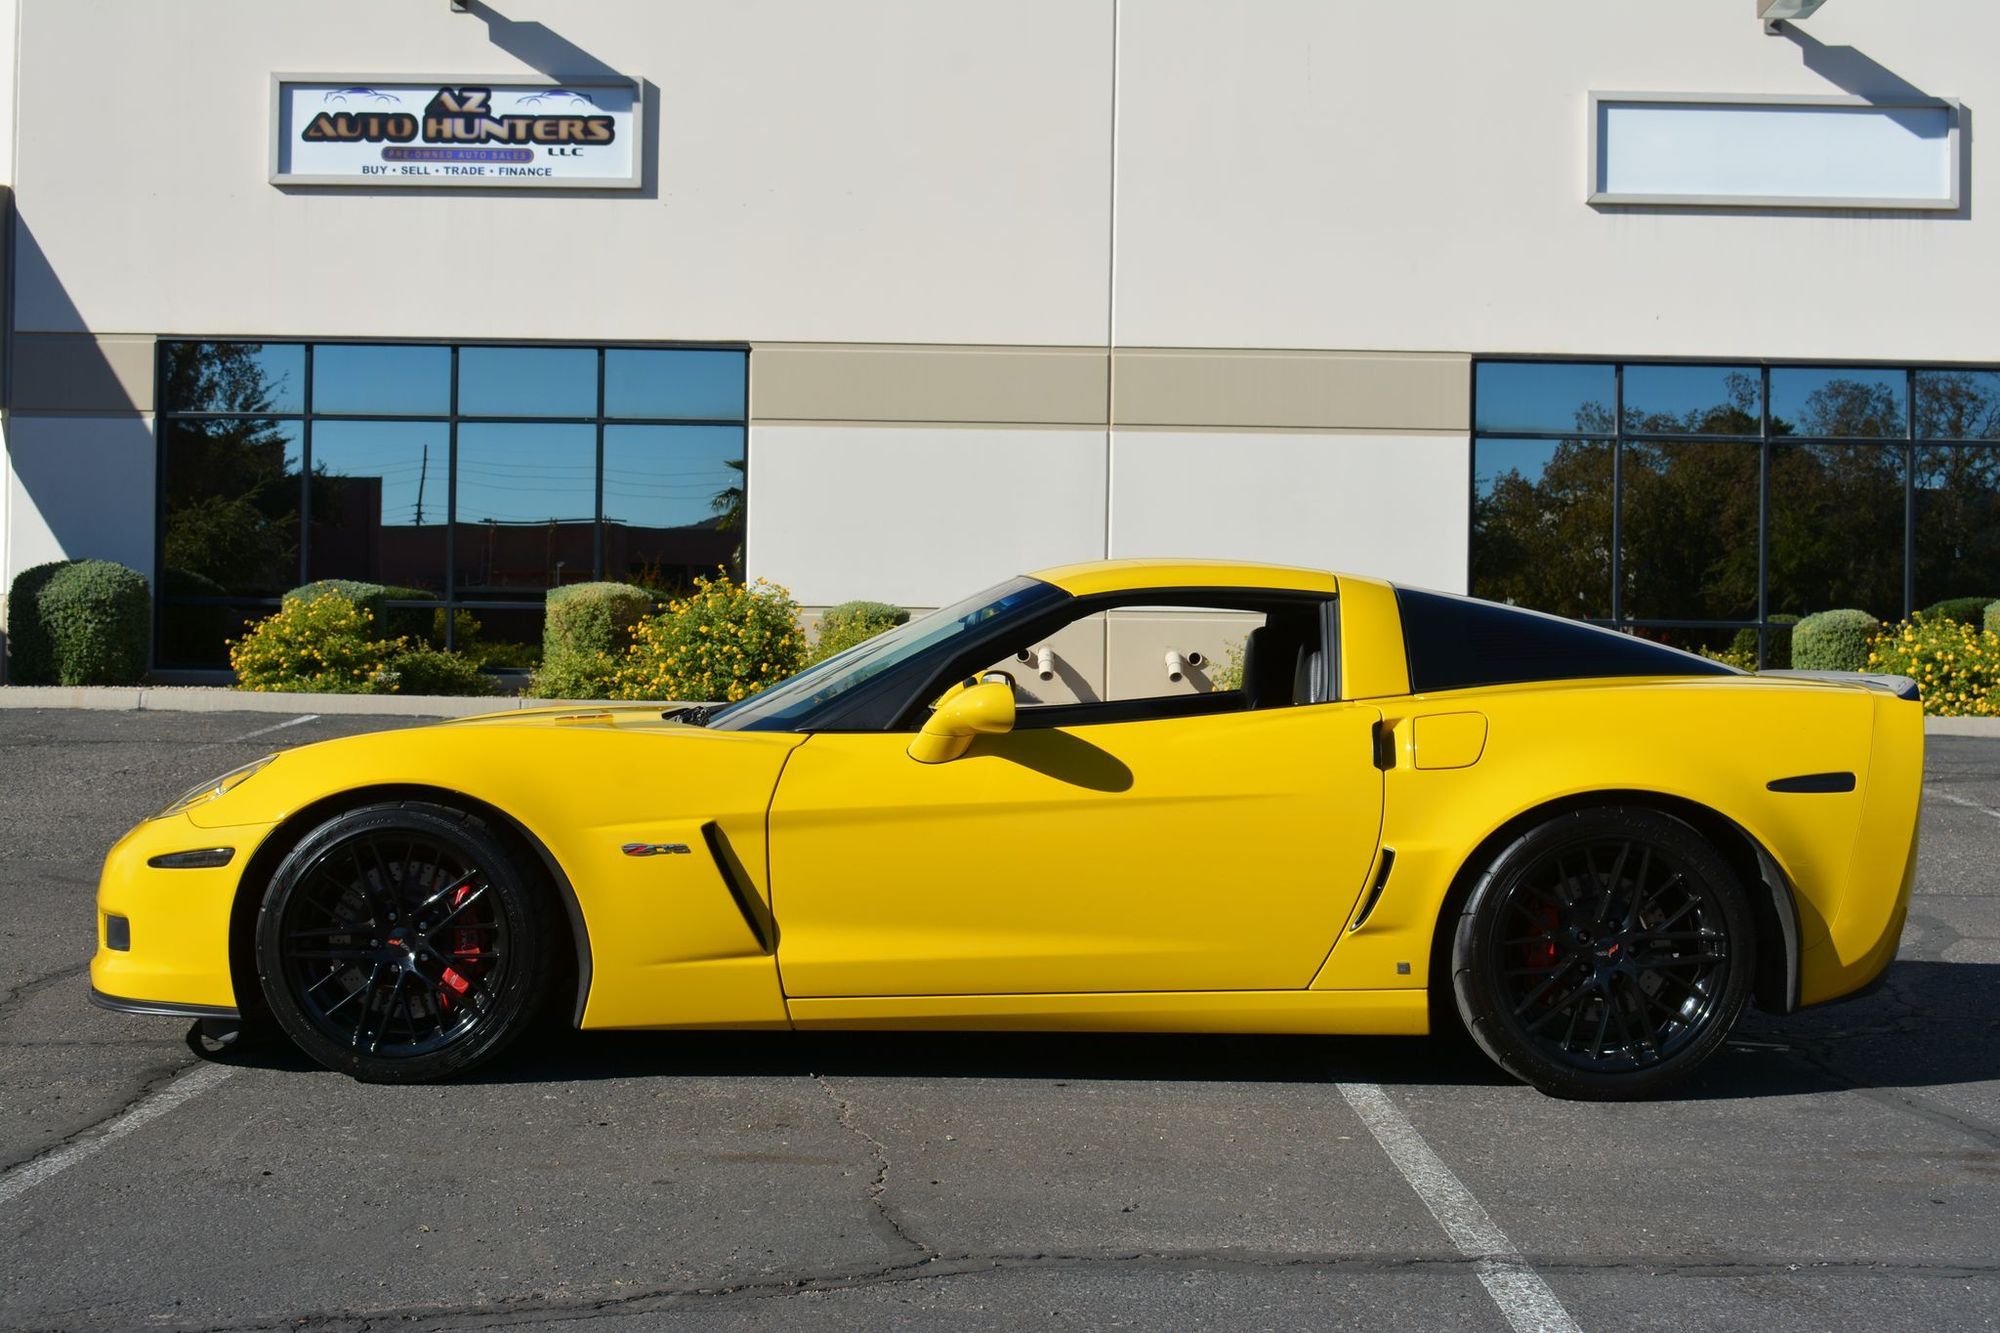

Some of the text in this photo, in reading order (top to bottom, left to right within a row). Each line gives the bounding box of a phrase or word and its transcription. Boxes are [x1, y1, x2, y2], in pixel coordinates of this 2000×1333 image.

[432, 88, 490, 114] AZ
[305, 114, 613, 142] AUTO HUNTERS
[387, 149, 528, 162] PRE-OWNED AUTO SALES
[548, 147, 584, 157] LLC
[362, 165, 552, 178] BUY SELL TRADE FINANCE
